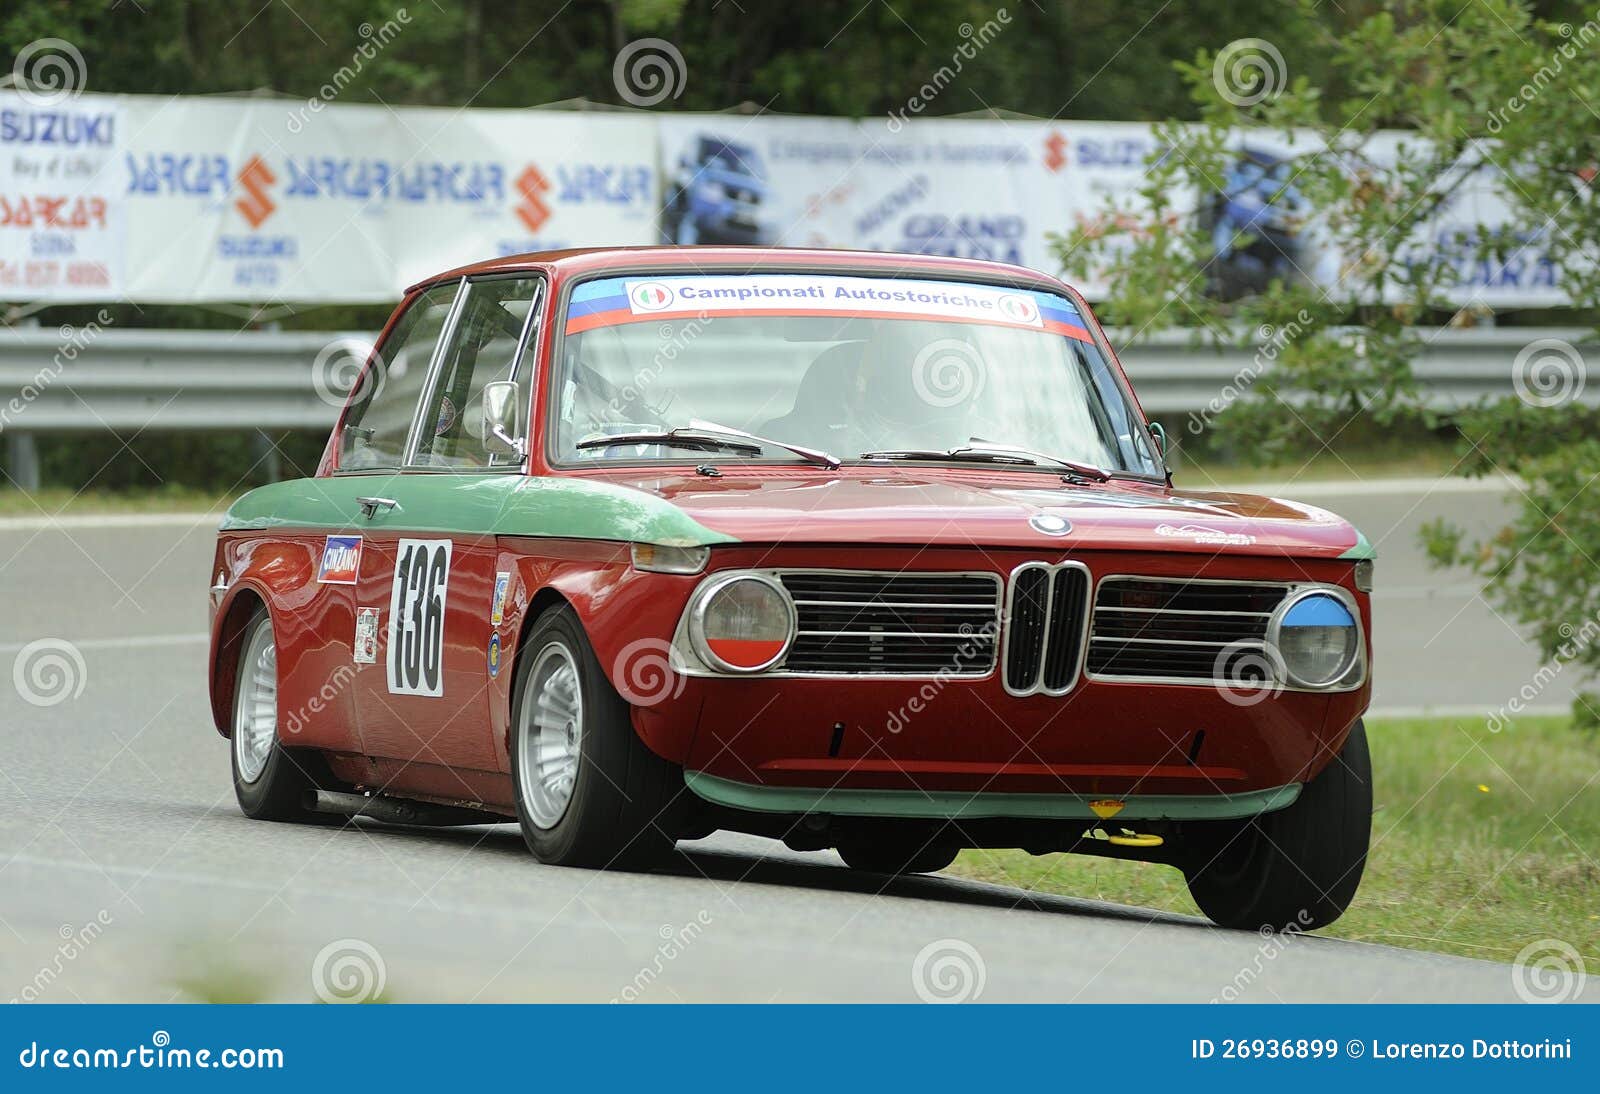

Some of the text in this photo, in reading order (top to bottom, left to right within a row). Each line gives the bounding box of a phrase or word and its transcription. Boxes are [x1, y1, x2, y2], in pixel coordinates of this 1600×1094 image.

[1, 111, 114, 145] SUZUKI
[904, 215, 1026, 239] GRAND
[679, 285, 993, 309] Campionati Autostoriche
[324, 547, 358, 572] CINZANO
[395, 544, 446, 692] 136
